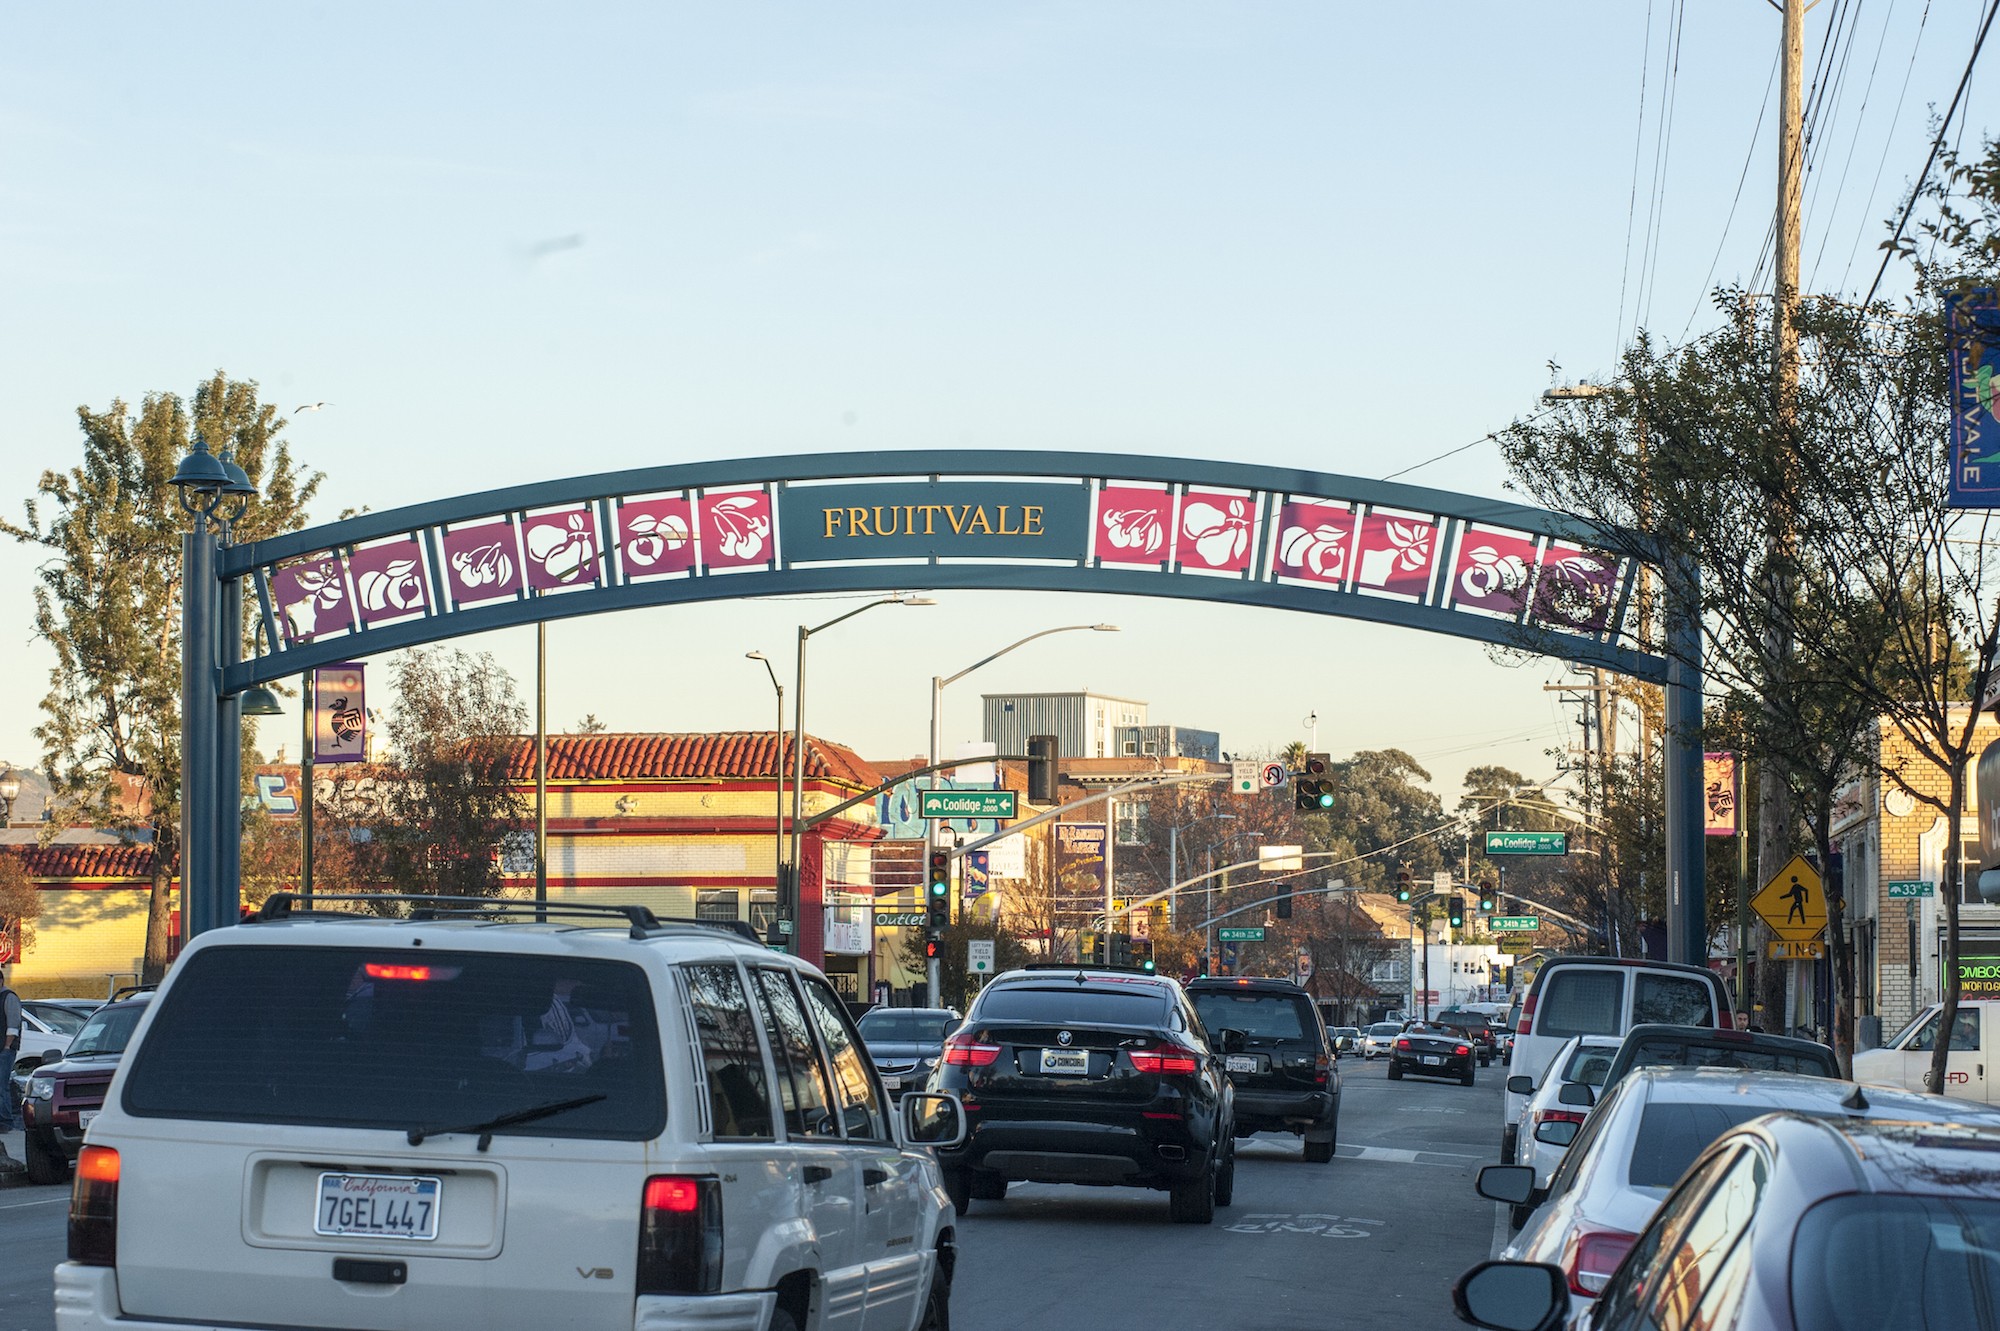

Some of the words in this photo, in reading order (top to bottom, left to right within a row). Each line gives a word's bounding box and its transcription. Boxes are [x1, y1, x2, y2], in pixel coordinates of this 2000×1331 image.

[822, 504, 1045, 538] FRUITVALE
[943, 798, 981, 813] Coolidge
[1503, 837, 1537, 851] Coolidge
[875, 913, 927, 926] Outlet
[1503, 920, 1518, 928] 34th
[1958, 965, 2000, 979] OMBOS
[343, 1178, 417, 1197] California
[324, 1196, 432, 1231] 7GEL447
[576, 1266, 614, 1280] V8
